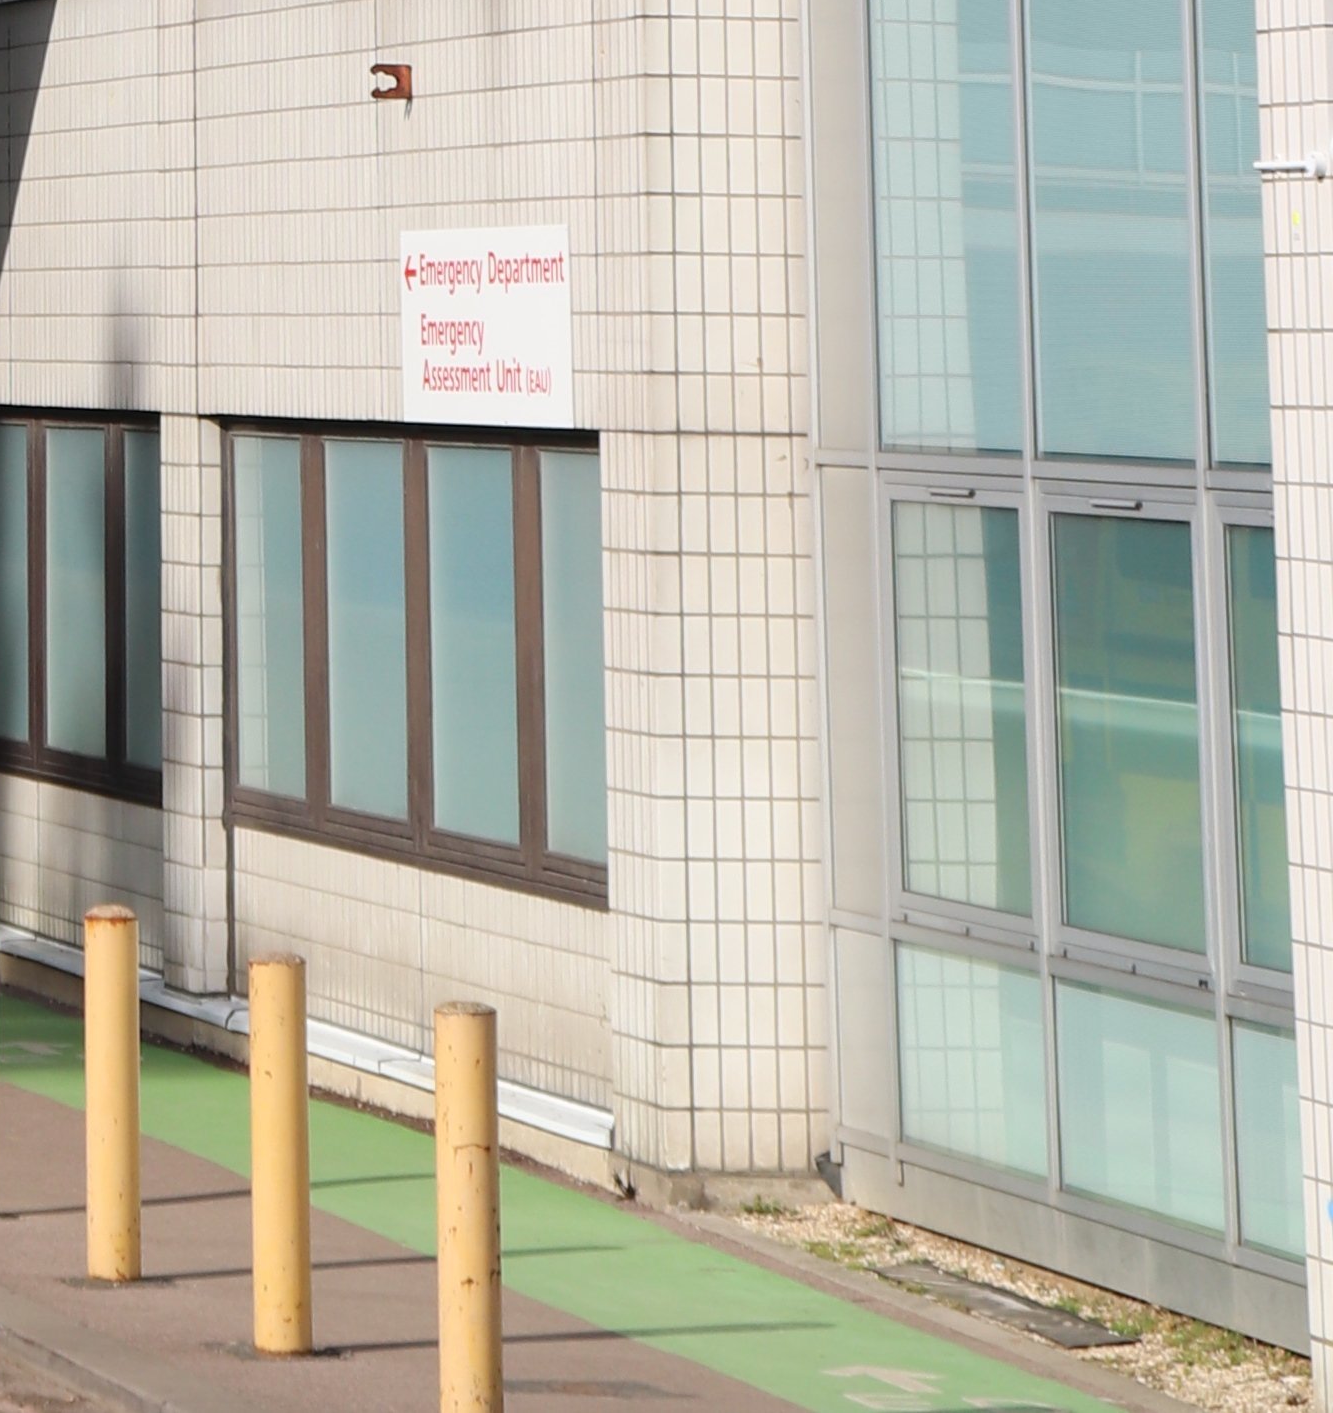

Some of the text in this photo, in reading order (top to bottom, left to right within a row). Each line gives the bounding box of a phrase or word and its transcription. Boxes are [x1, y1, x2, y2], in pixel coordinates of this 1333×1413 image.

[420, 251, 564, 294] Emergency Department
[421, 314, 483, 355] Emergency
[423, 358, 551, 396] Assessment Unit (EAU)
